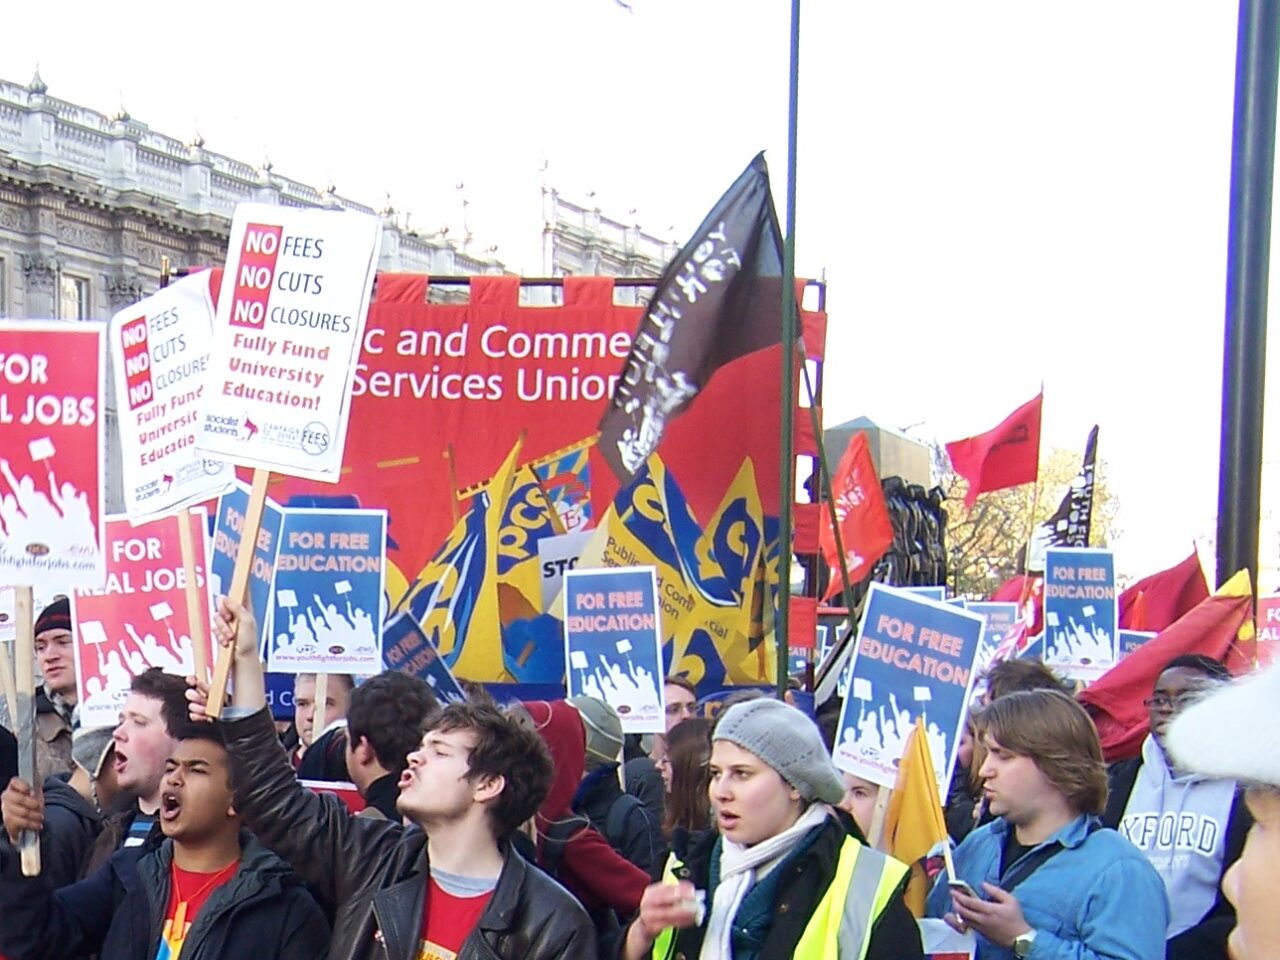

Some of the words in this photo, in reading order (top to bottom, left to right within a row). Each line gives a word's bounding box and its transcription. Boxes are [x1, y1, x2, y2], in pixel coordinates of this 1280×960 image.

[246, 230, 278, 255] NO
[283, 236, 324, 259] FEES
[240, 264, 271, 290] NO
[278, 270, 324, 295] CUTS
[122, 323, 147, 348] NO
[150, 307, 180, 335] FEES
[234, 299, 264, 324] NO
[271, 306, 352, 334] CLOSURES
[126, 352, 150, 377] NO
[153, 334, 187, 363] CUTS
[233, 333, 277, 356] Fully
[282, 340, 331, 361] Fund
[396, 323, 468, 358] and
[480, 324, 632, 359] Comme
[229, 357, 325, 388] University
[351, 363, 503, 400] Services
[130, 381, 152, 405] NO
[222, 381, 321, 411] Education!
[20, 394, 96, 427] JOBS
[137, 402, 167, 426] Fully
[139, 410, 199, 445] Universi
[140, 434, 196, 467] Educatio
[112, 537, 162, 562] FOR
[289, 532, 325, 550] FOR
[330, 533, 370, 550] FREE
[606, 536, 641, 567] Public
[277, 555, 381, 573] EDUCATION
[1053, 567, 1075, 580] FOR
[1078, 567, 1106, 581] FREE
[576, 592, 605, 610] FOR
[608, 591, 644, 608] FREE
[1046, 585, 1114, 599] EDUCATION
[568, 614, 655, 633] EDUCATION
[877, 614, 915, 643] FOR
[918, 627, 964, 658] FREE
[858, 636, 970, 688] EDUCATION
